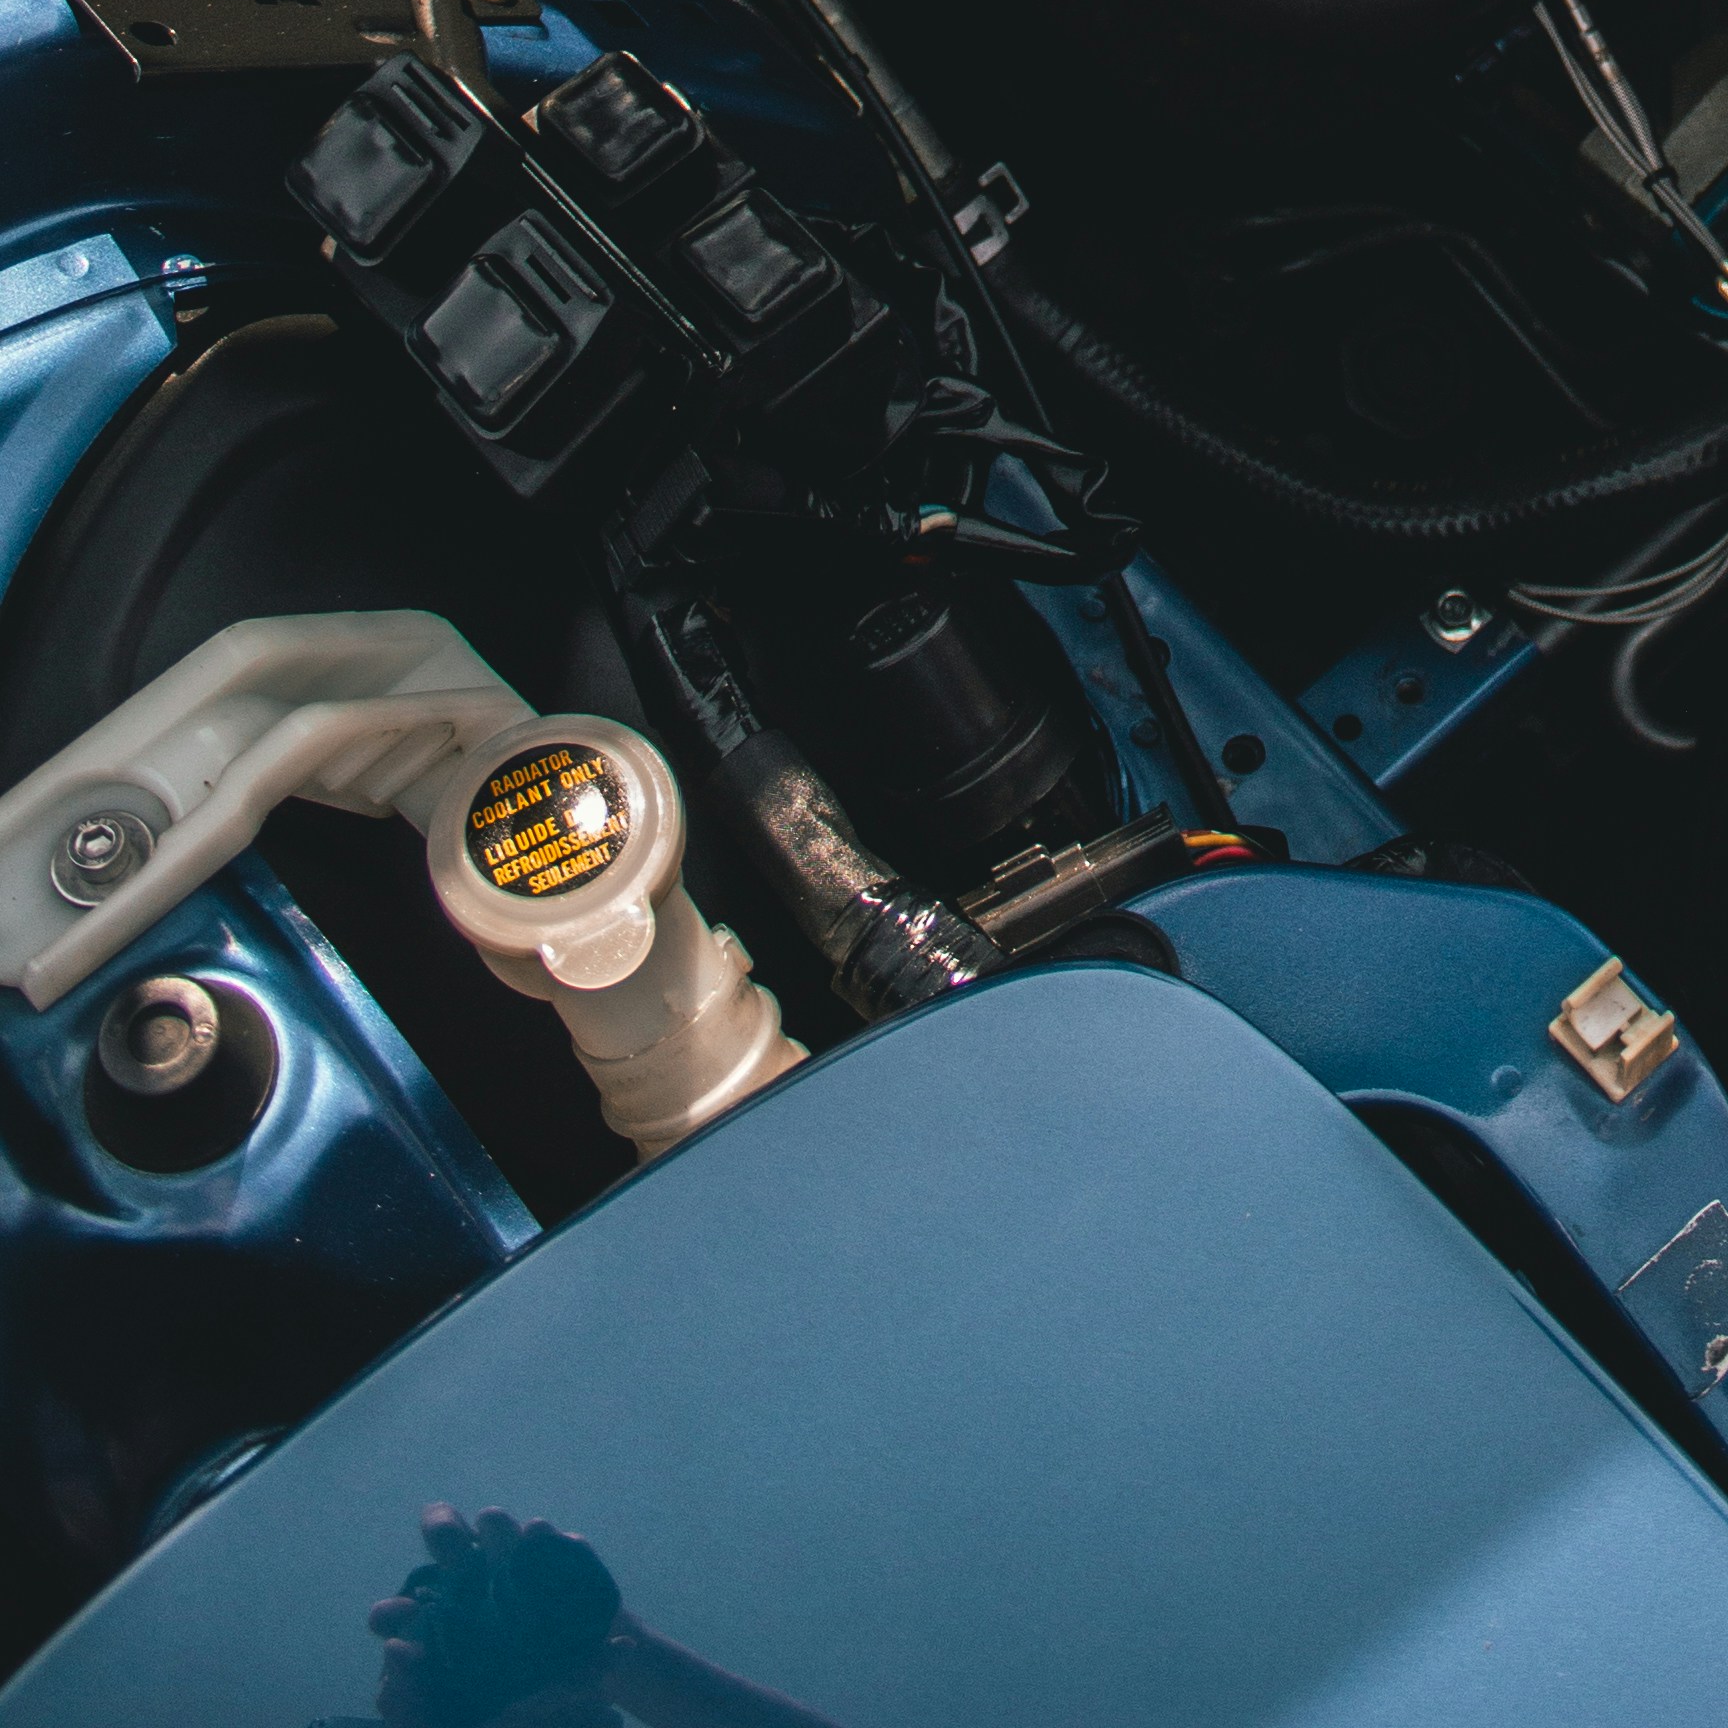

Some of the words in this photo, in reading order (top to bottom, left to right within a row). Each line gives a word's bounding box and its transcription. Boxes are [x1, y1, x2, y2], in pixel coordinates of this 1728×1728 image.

[470, 778, 553, 830] COOLANT
[559, 756, 606, 790] ONLY
[489, 748, 574, 798] RADIATOR
[484, 815, 561, 867] LIQUIDE
[527, 841, 612, 895] SEULEMENT
